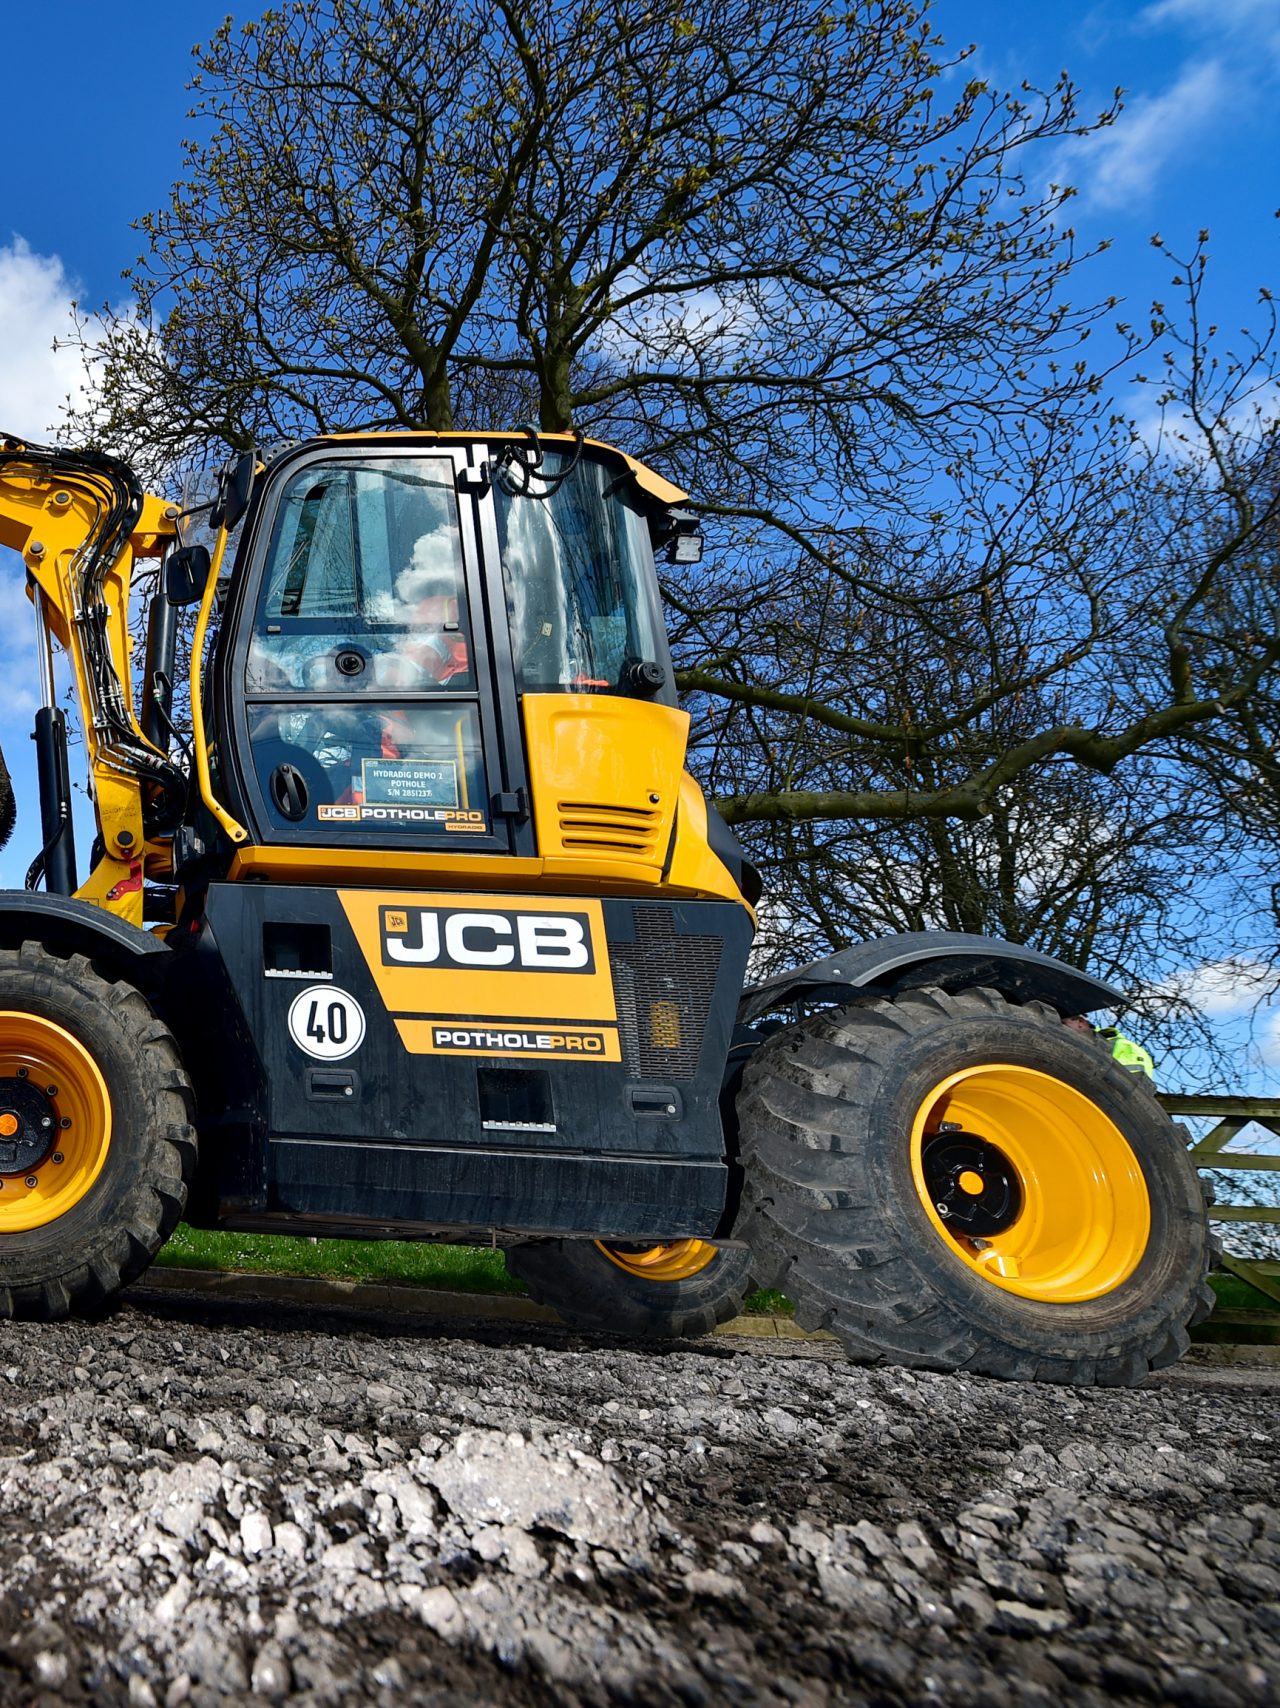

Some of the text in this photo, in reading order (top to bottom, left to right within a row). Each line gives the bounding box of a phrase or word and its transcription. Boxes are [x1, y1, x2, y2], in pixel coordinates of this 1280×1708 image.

[373, 770, 412, 779] HYDRADIG
[413, 772, 436, 780] DEMO
[391, 780, 426, 788] POTHOLE
[387, 789, 400, 797] S/N
[321, 808, 358, 818] JCB
[386, 912, 589, 968] JCB
[306, 1000, 347, 1044] 40
